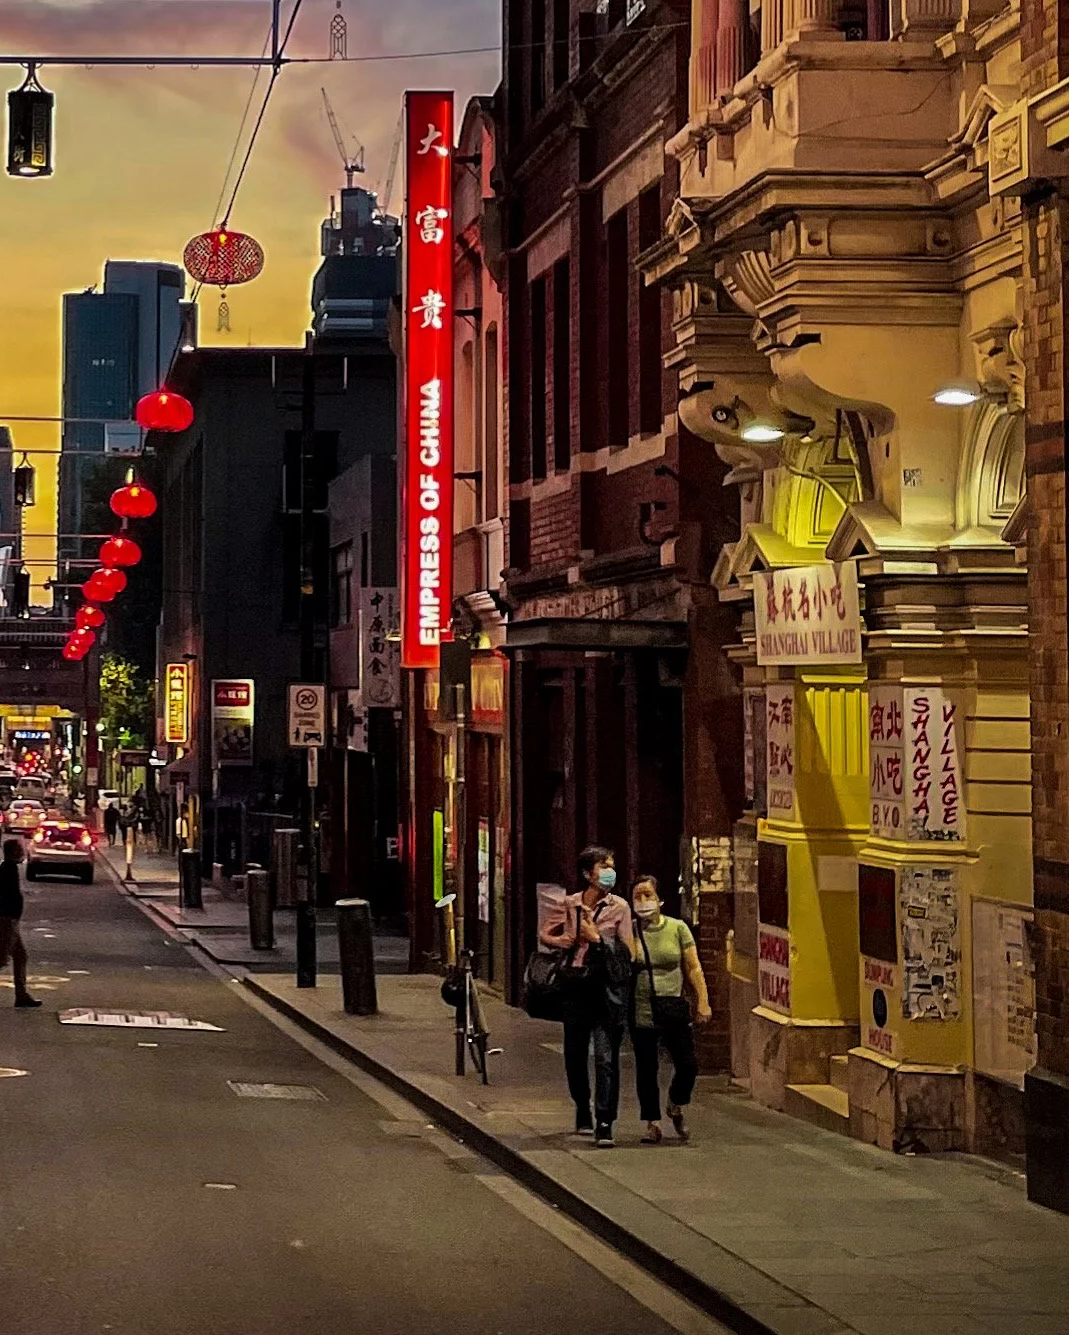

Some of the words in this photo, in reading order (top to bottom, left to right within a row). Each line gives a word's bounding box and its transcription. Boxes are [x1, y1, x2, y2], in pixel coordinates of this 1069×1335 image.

[420, 378, 441, 468] CHINA
[420, 476, 441, 512] OF
[419, 518, 442, 647] EMPRESS
[761, 632, 809, 656] SHANGHAI
[812, 629, 857, 654] VILLAGE
[300, 694, 315, 705] 20
[911, 697, 931, 828] SHANGHAI
[940, 704, 959, 825] VILLAGE
